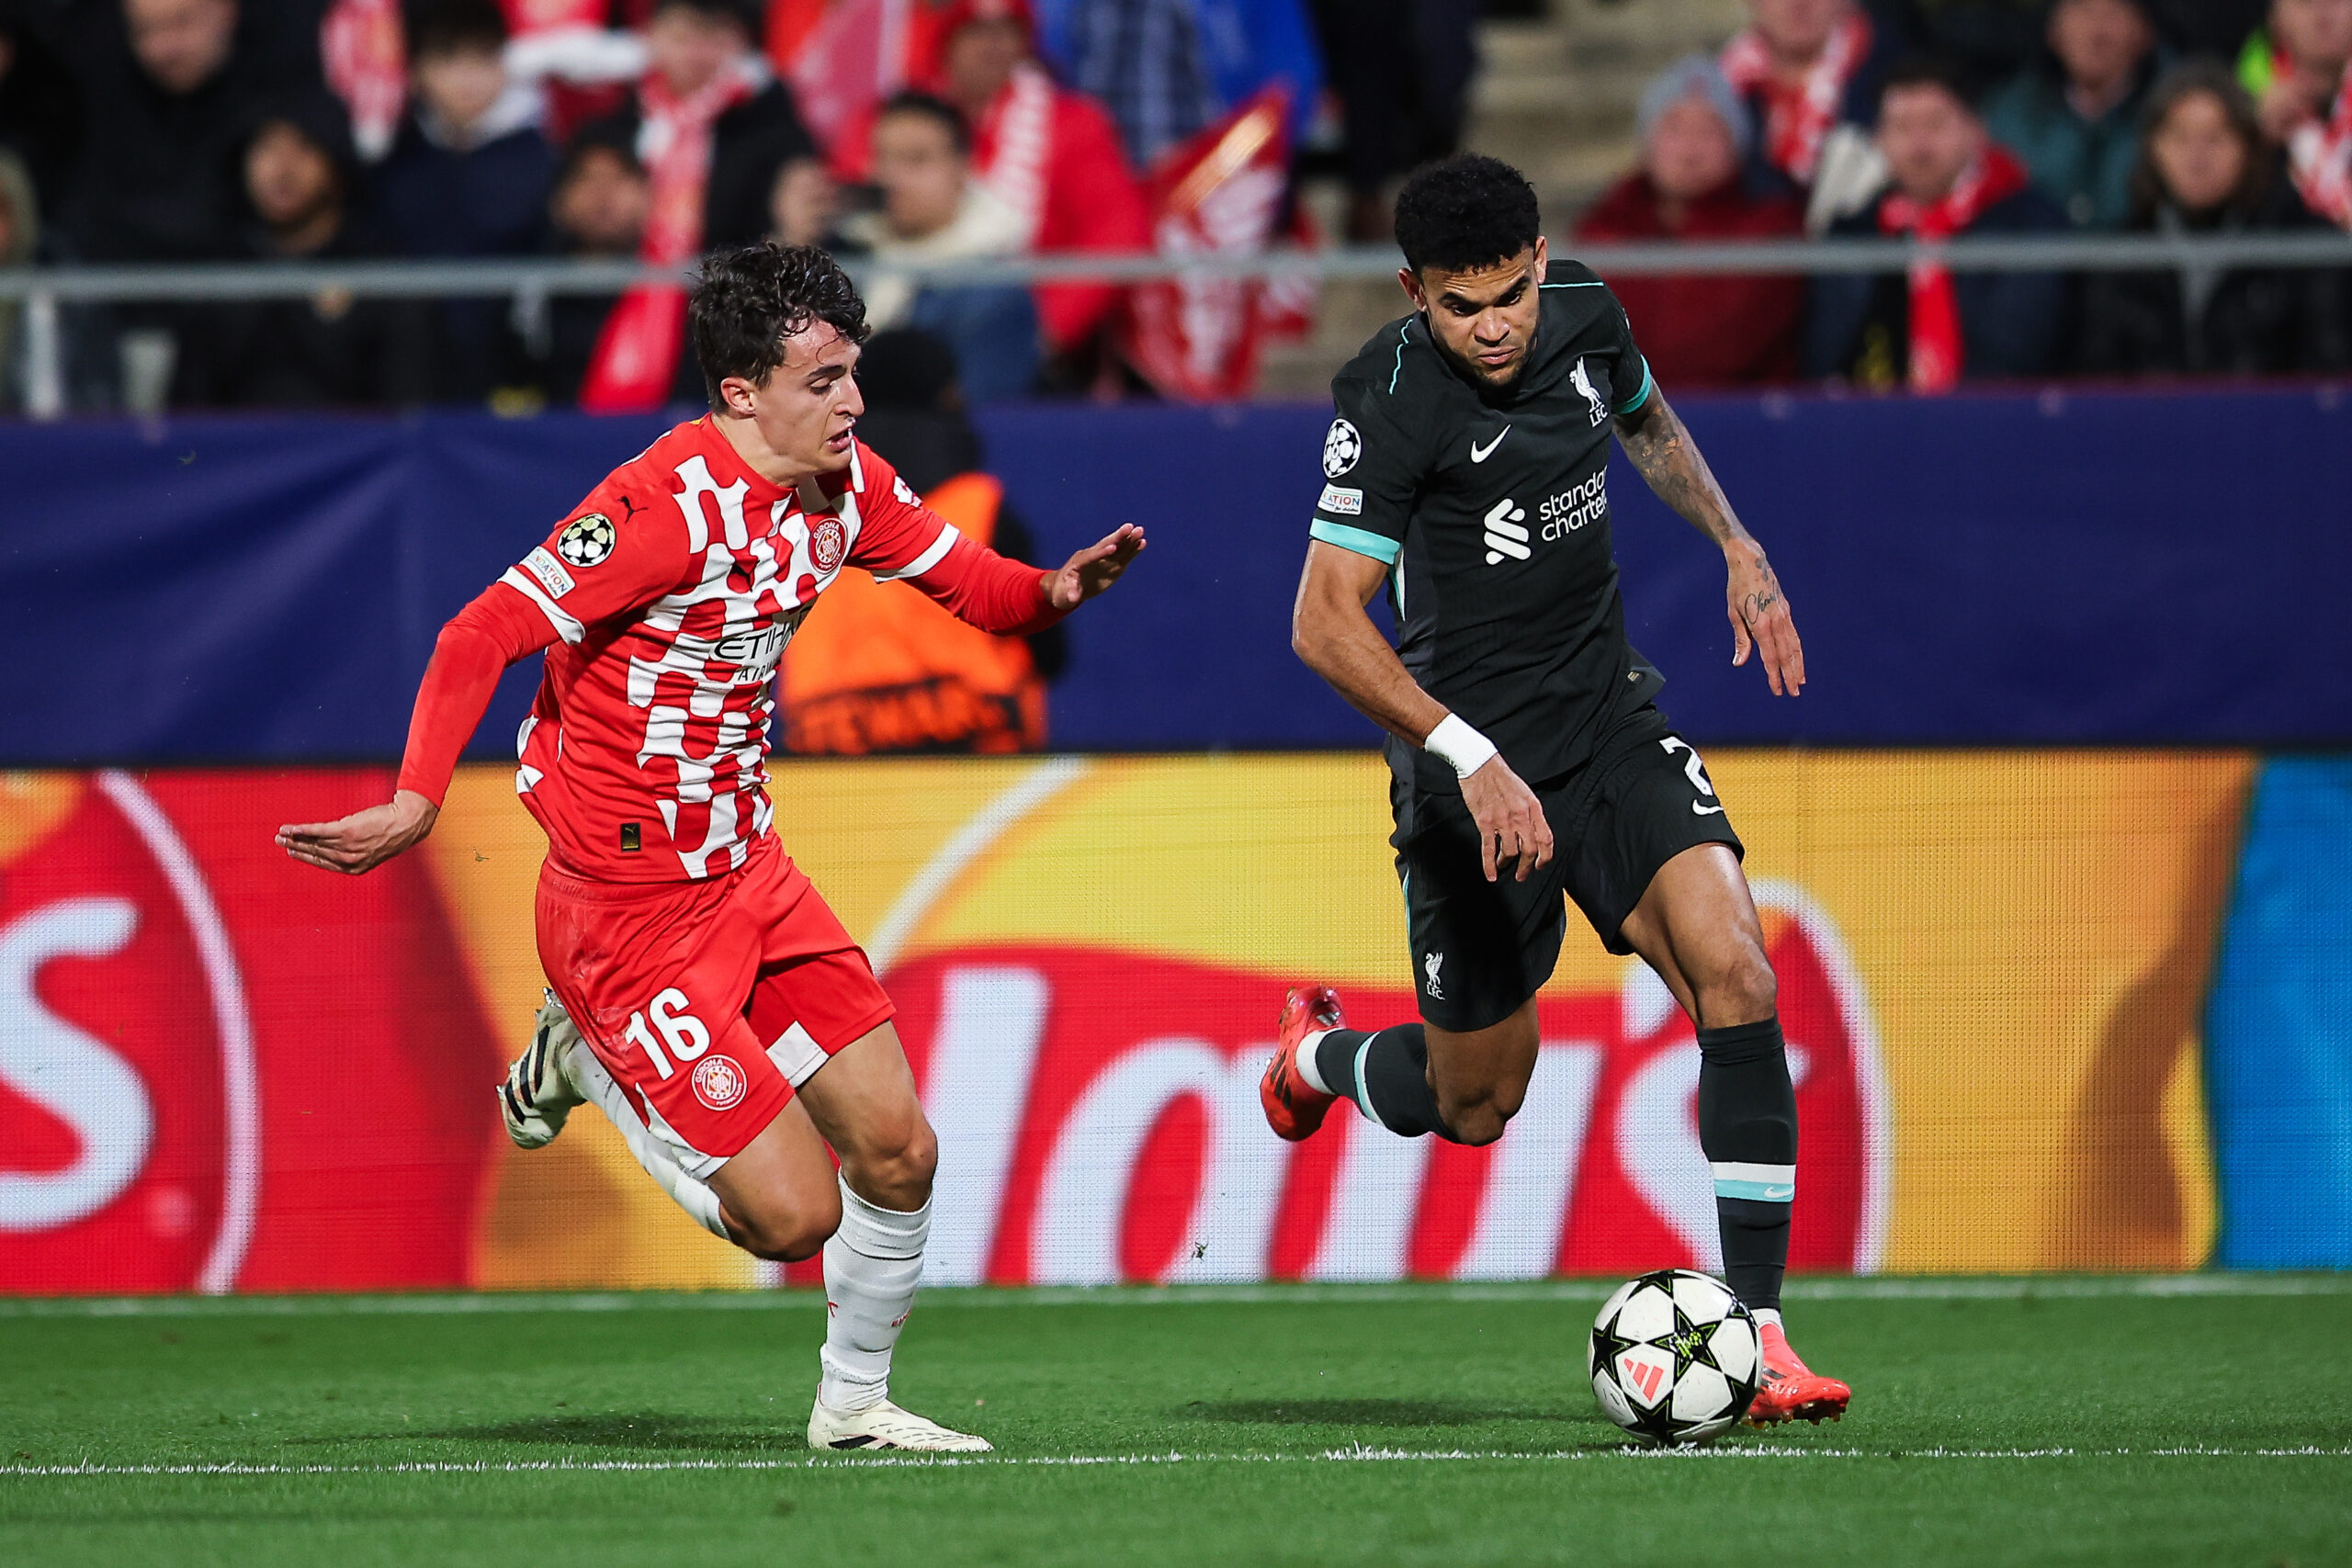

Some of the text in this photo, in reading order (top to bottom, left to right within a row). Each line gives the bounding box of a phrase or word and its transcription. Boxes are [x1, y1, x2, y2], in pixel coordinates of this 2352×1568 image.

[813, 522, 841, 539] GIRONA
[625, 987, 711, 1081] 16
[695, 1058, 724, 1083] GIRONA
